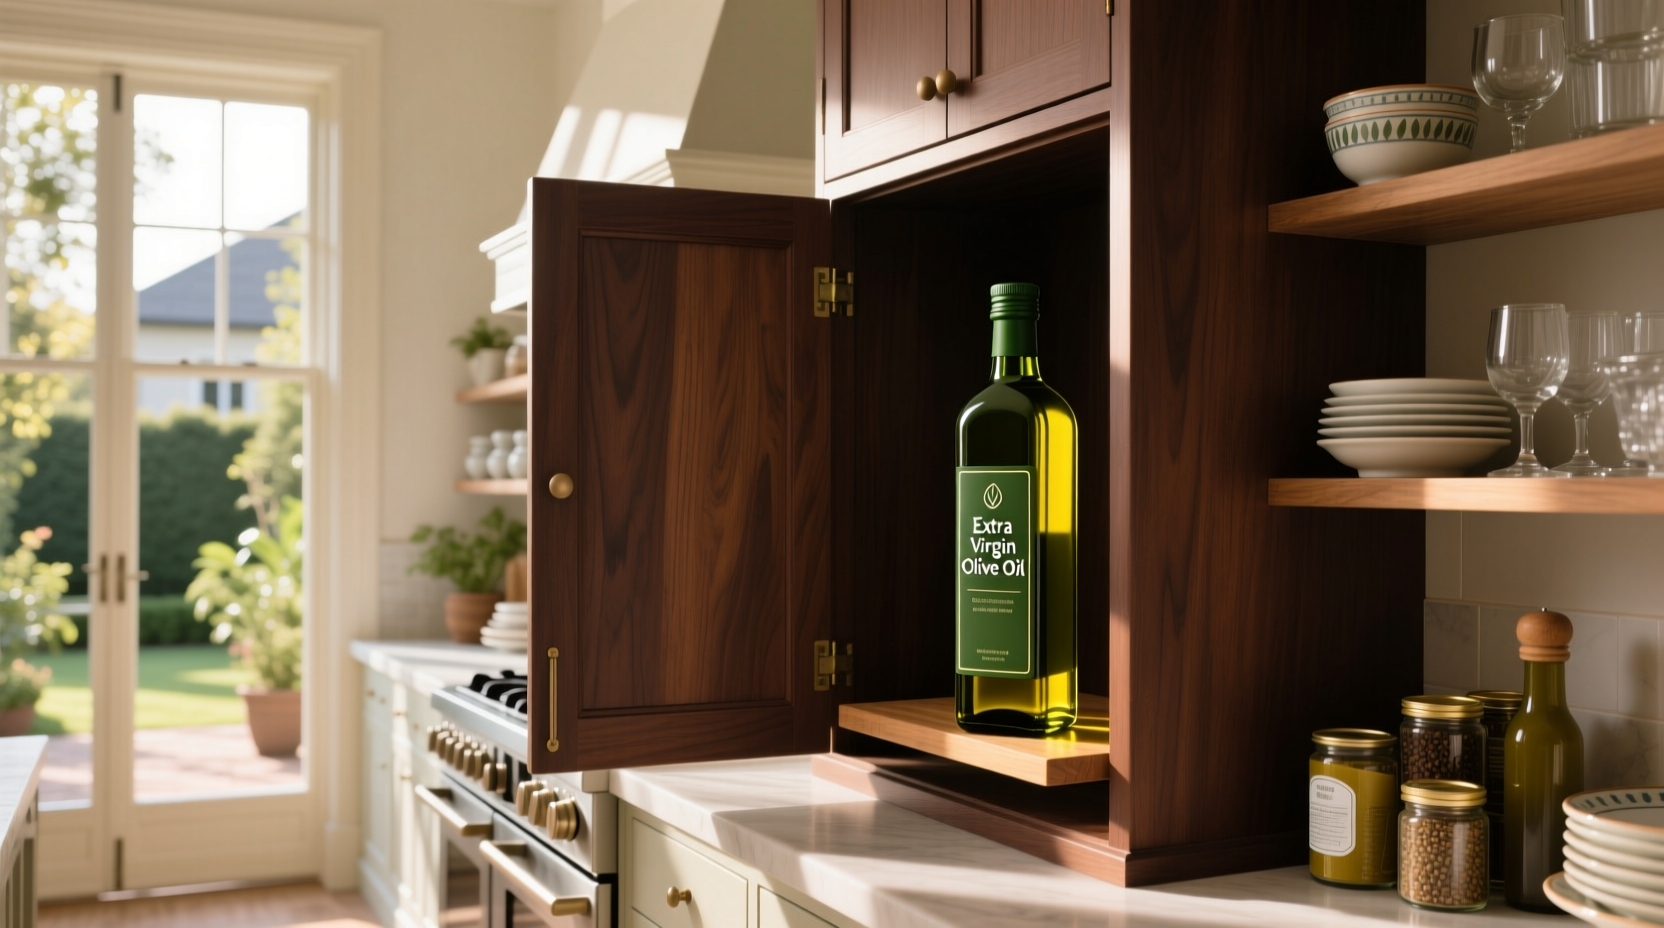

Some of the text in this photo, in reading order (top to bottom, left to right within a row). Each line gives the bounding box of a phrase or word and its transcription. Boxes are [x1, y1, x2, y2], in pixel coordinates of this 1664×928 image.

[972, 516, 1013, 535] Extra
[970, 537, 1016, 560] Virgin
[961, 557, 1025, 577] Olive Oil
